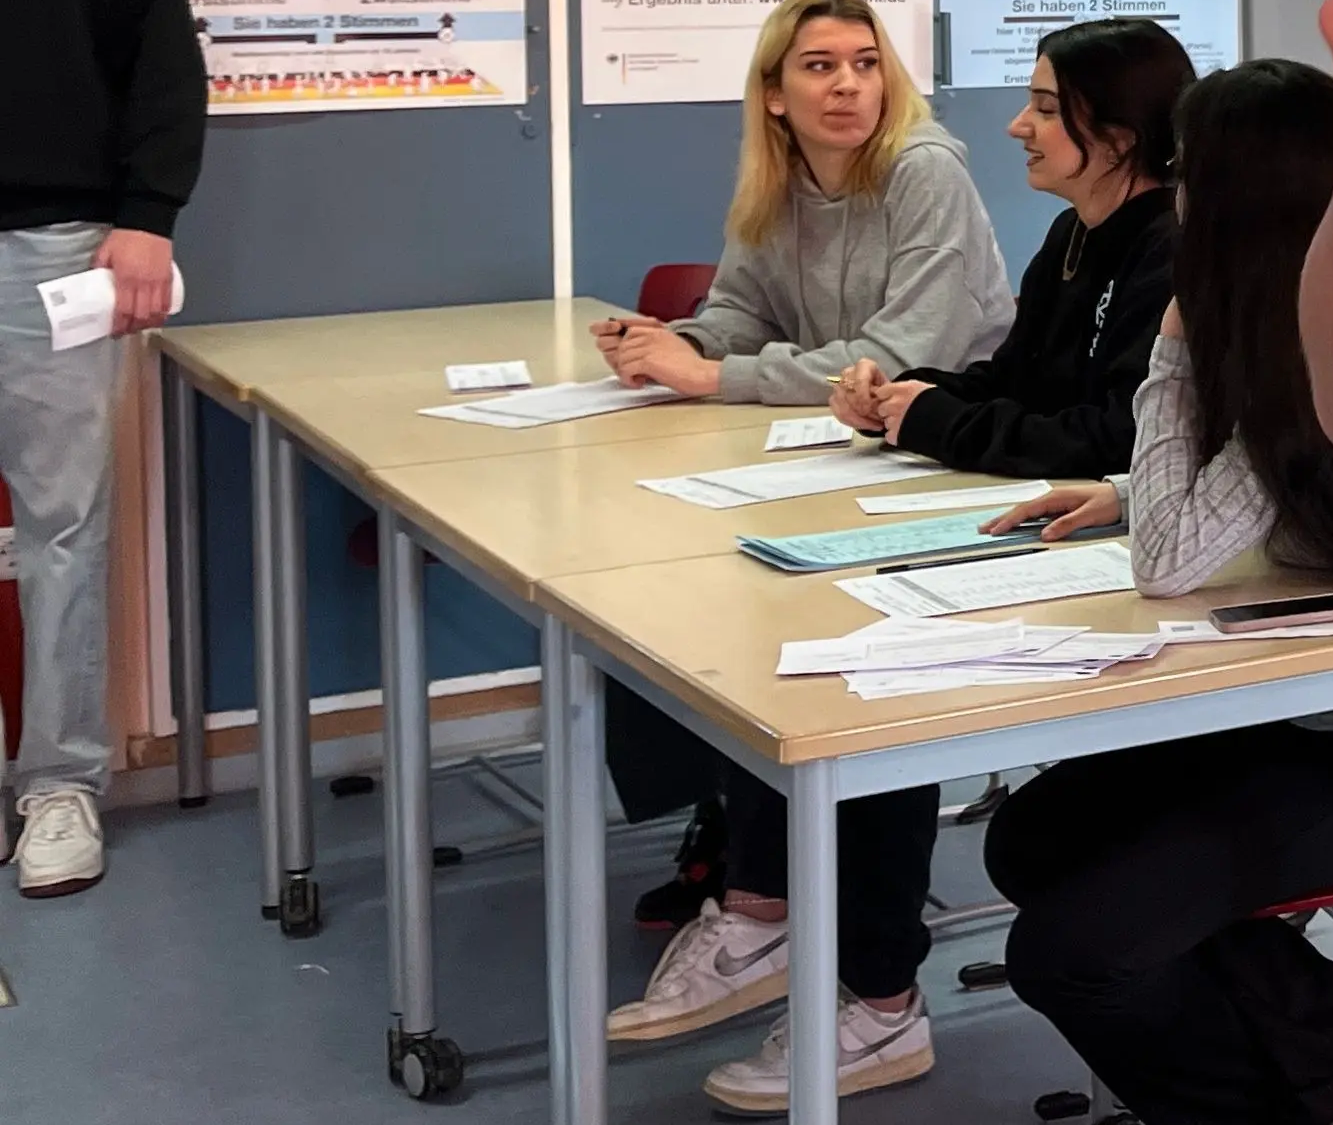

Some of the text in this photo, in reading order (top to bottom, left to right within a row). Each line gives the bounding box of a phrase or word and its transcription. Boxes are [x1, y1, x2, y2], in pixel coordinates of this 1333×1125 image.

[1012, 0, 1166, 12] Sie haben 2 Stimmen
[233, 15, 418, 29] Sie haben 2 Stimmen
